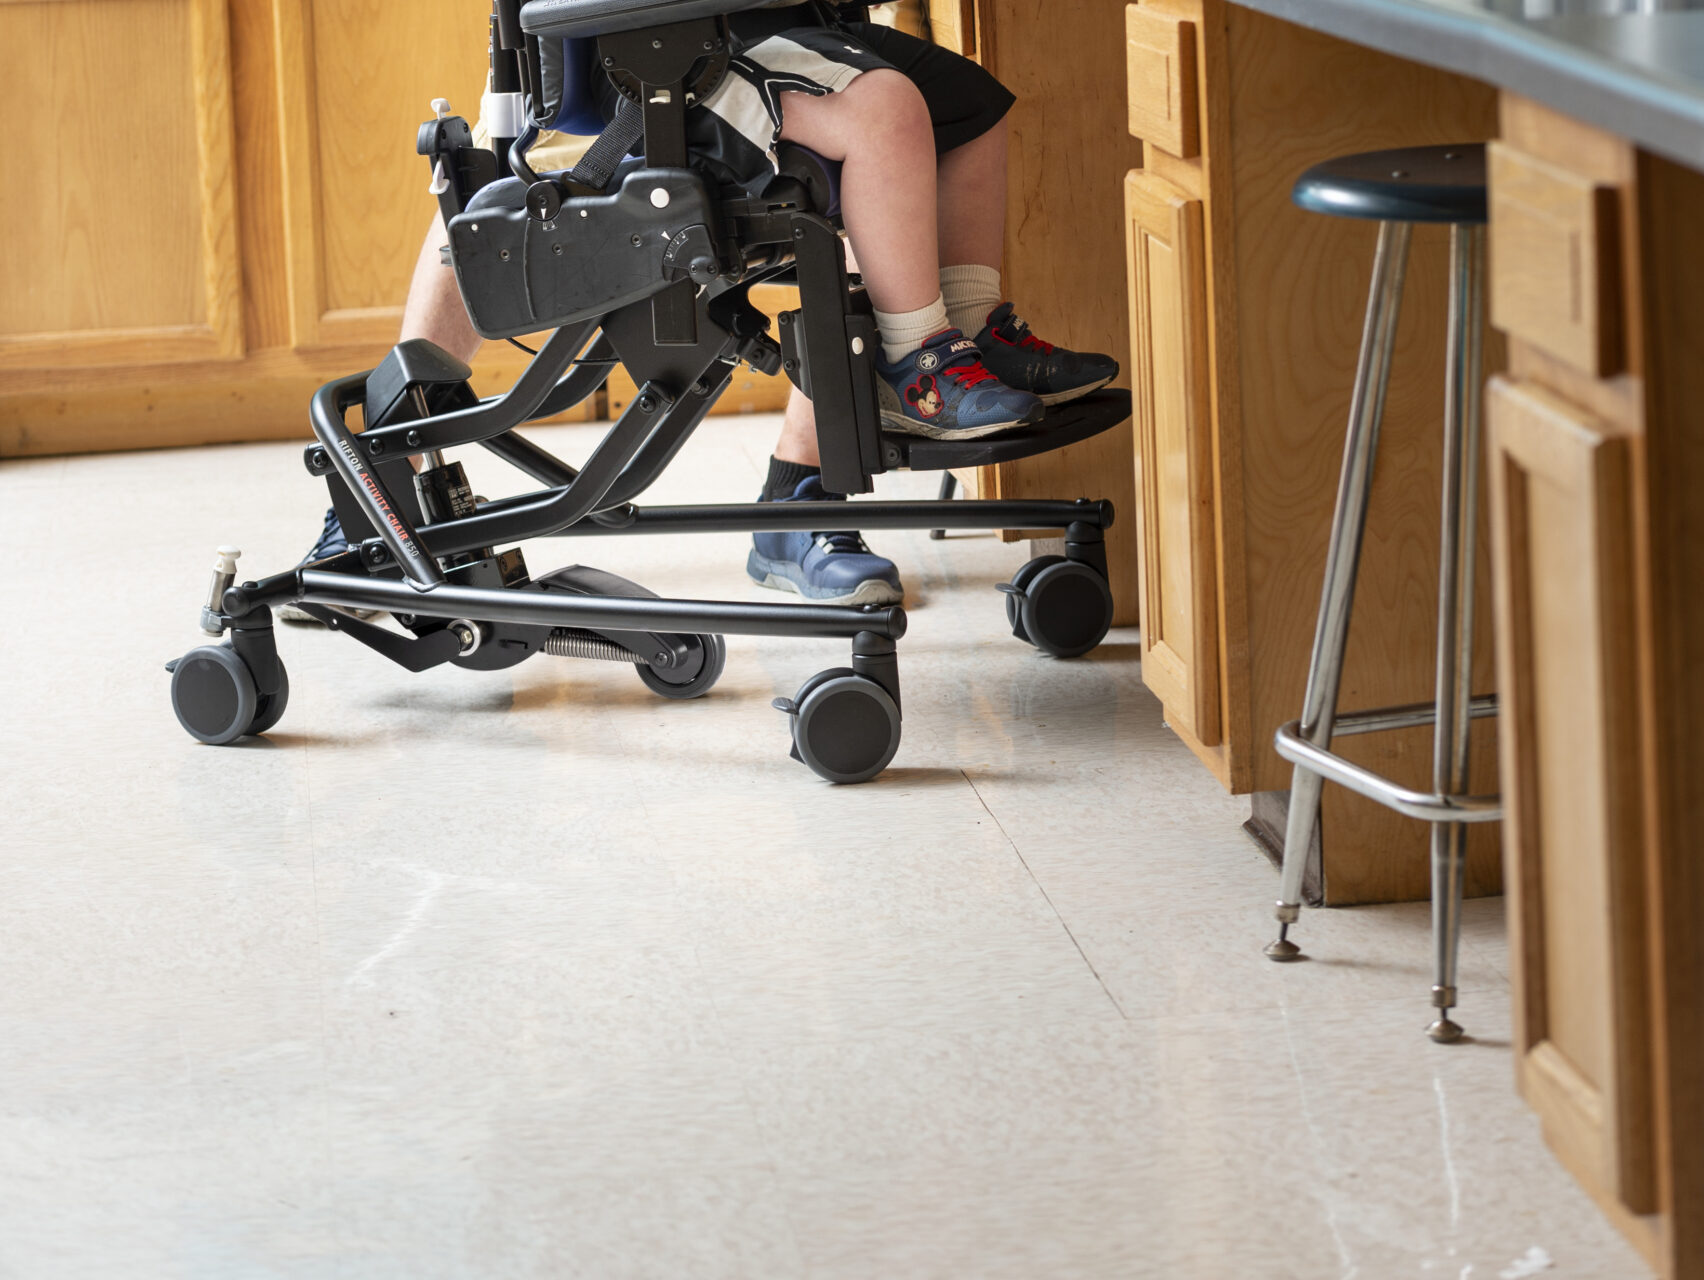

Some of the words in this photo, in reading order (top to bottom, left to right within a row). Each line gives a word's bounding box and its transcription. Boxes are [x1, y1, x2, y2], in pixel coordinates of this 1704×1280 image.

[950, 340, 977, 352] MICKE
[339, 439, 364, 471] RIFTON
[360, 472, 391, 512] ACTIVITY
[387, 513, 409, 541] CHAIR
[404, 539, 420, 557] 850
